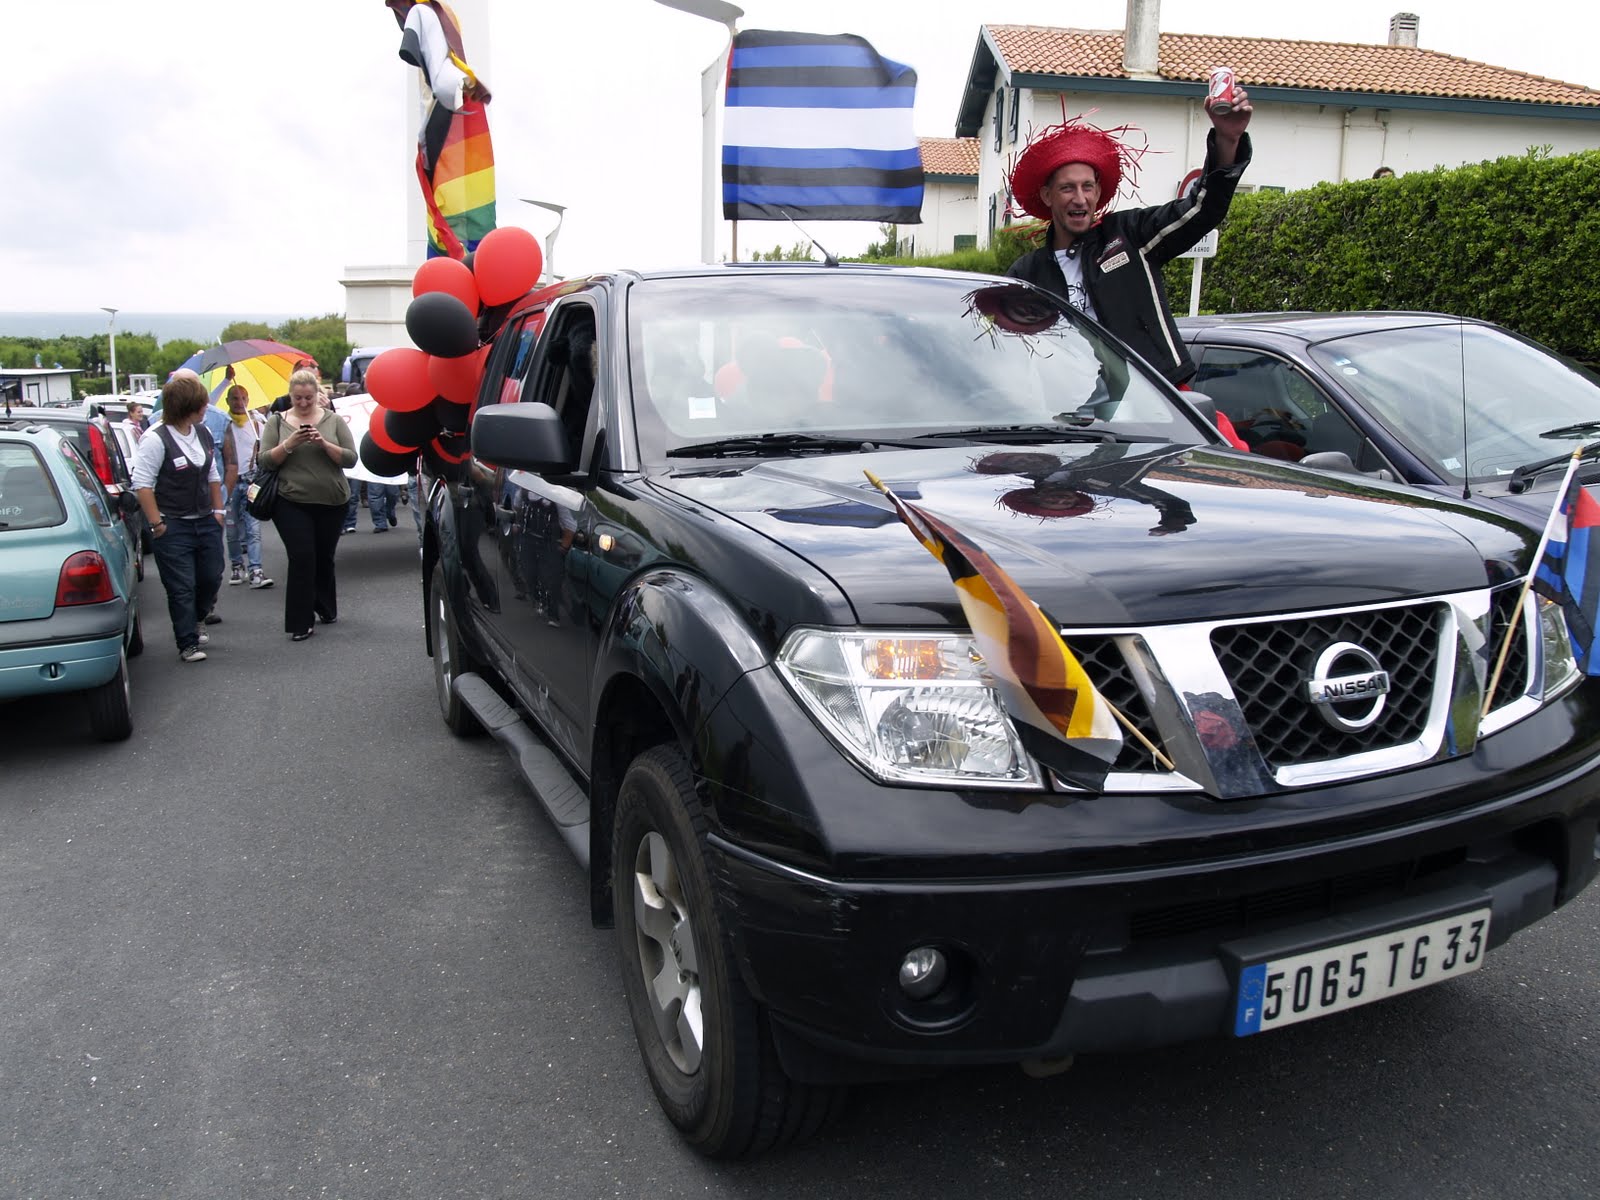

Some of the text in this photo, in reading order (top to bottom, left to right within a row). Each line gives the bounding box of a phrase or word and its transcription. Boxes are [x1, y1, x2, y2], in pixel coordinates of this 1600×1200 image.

[1323, 677, 1386, 698] NISSAN
[1263, 919, 1485, 1021] 5065 TG 33
[1244, 1007, 1255, 1023] F
